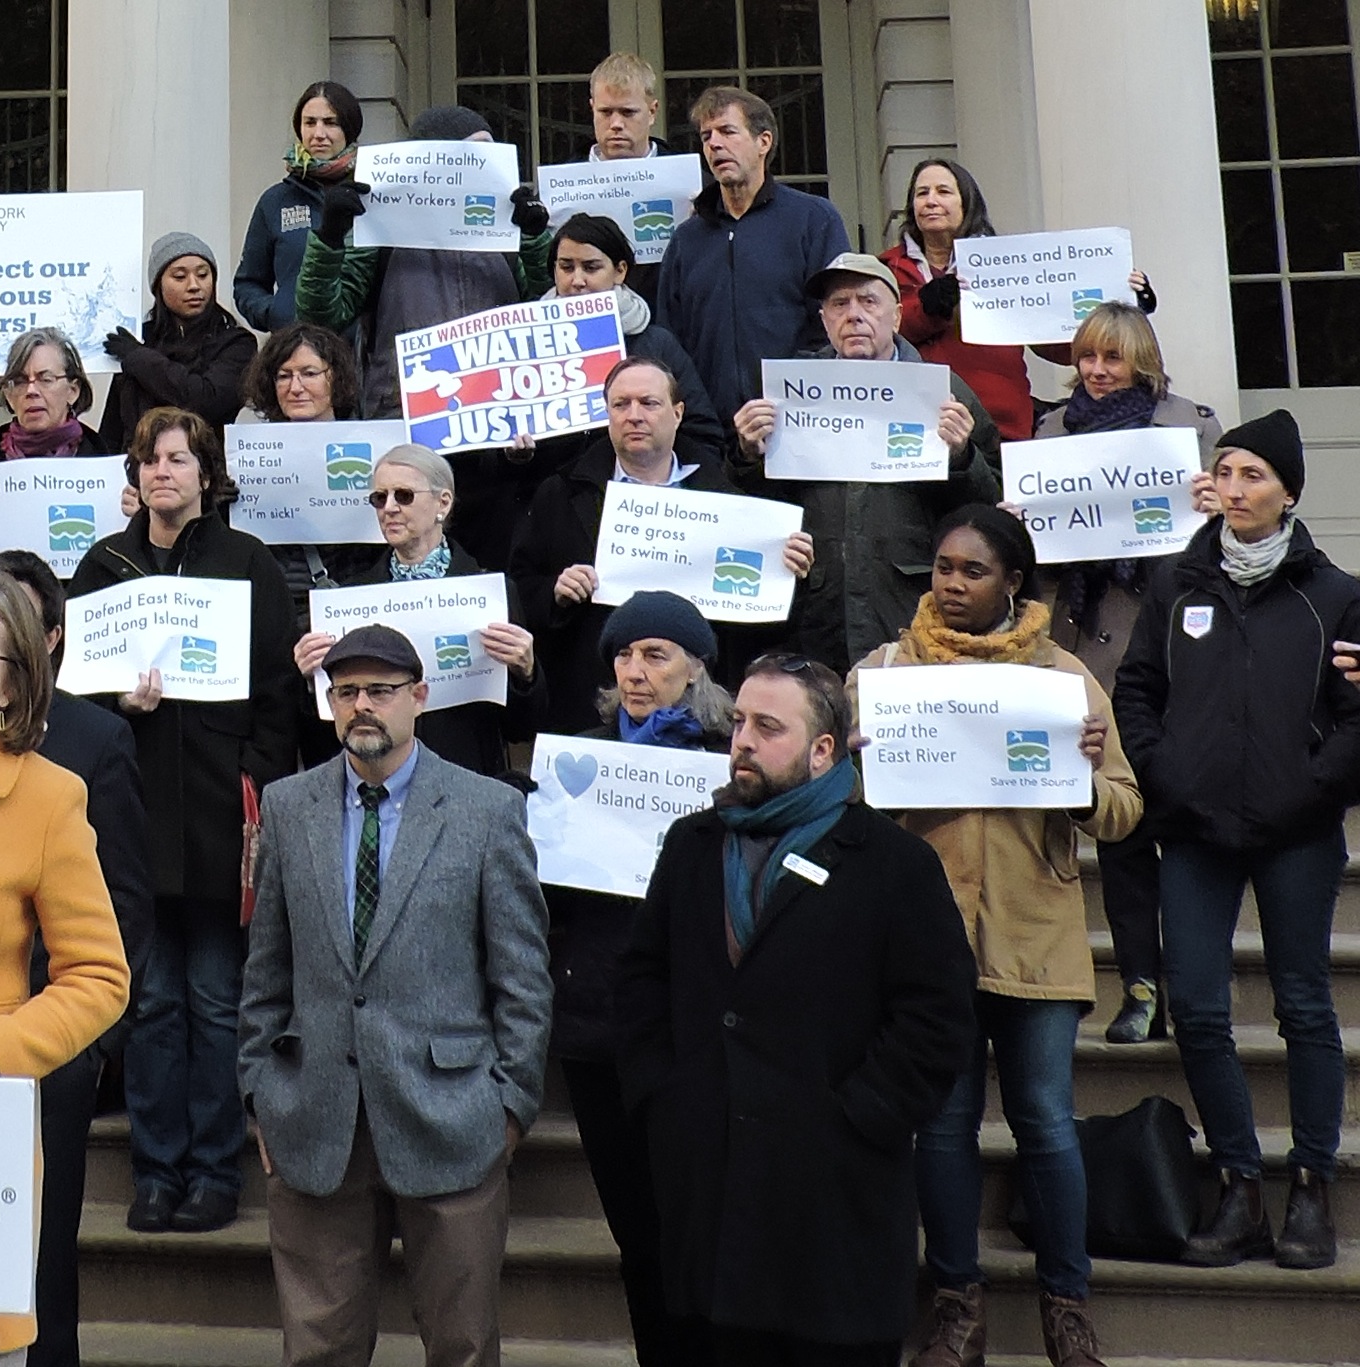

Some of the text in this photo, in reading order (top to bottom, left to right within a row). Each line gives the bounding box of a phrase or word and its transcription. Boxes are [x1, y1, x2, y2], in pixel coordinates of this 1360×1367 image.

[373, 152, 487, 169] Safe and Healthy
[371, 171, 462, 185] Waters for all
[549, 171, 655, 188] Data makes invisible
[370, 193, 456, 207] New Yorkers
[551, 188, 634, 206] pollution visible.
[968, 245, 1113, 267] Queens and Bronx
[40, 261, 90, 278] our
[971, 269, 1077, 289] deserve clean
[972, 292, 1051, 310] water too!
[401, 296, 614, 353] TEXT WATERFORALL TO 69866
[452, 322, 582, 371] WATER
[491, 358, 587, 401] JOBS
[784, 379, 894, 401] No more
[440, 393, 591, 448] JUSTICE
[784, 411, 865, 433] Nitrogen
[238, 439, 284, 450] Because
[238, 457, 282, 468] the East
[5, 476, 27, 492] the
[34, 475, 105, 493] Nitrogen
[240, 473, 300, 485] River can't
[1018, 465, 1186, 495] Clean Water
[240, 494, 260, 505] say
[309, 497, 337, 507] Save
[340, 497, 360, 506] the
[617, 499, 719, 524] Algal blooms
[1020, 504, 1103, 531] for All
[614, 523, 686, 542] are gross
[610, 542, 693, 566] to swim in.
[84, 592, 212, 623] Defend East River
[324, 593, 487, 620] Sewage doesn't belong
[690, 595, 742, 611] Save the
[84, 611, 198, 643] and Long Island
[83, 638, 127, 662] Sound
[874, 700, 999, 715] Save the Sound
[876, 724, 938, 739] and the
[877, 748, 957, 763] East River
[600, 765, 610, 778] a
[614, 763, 660, 784] clean
[665, 769, 707, 792] Long
[990, 777, 1038, 787] Save the
[596, 789, 705, 817] Island Sound
